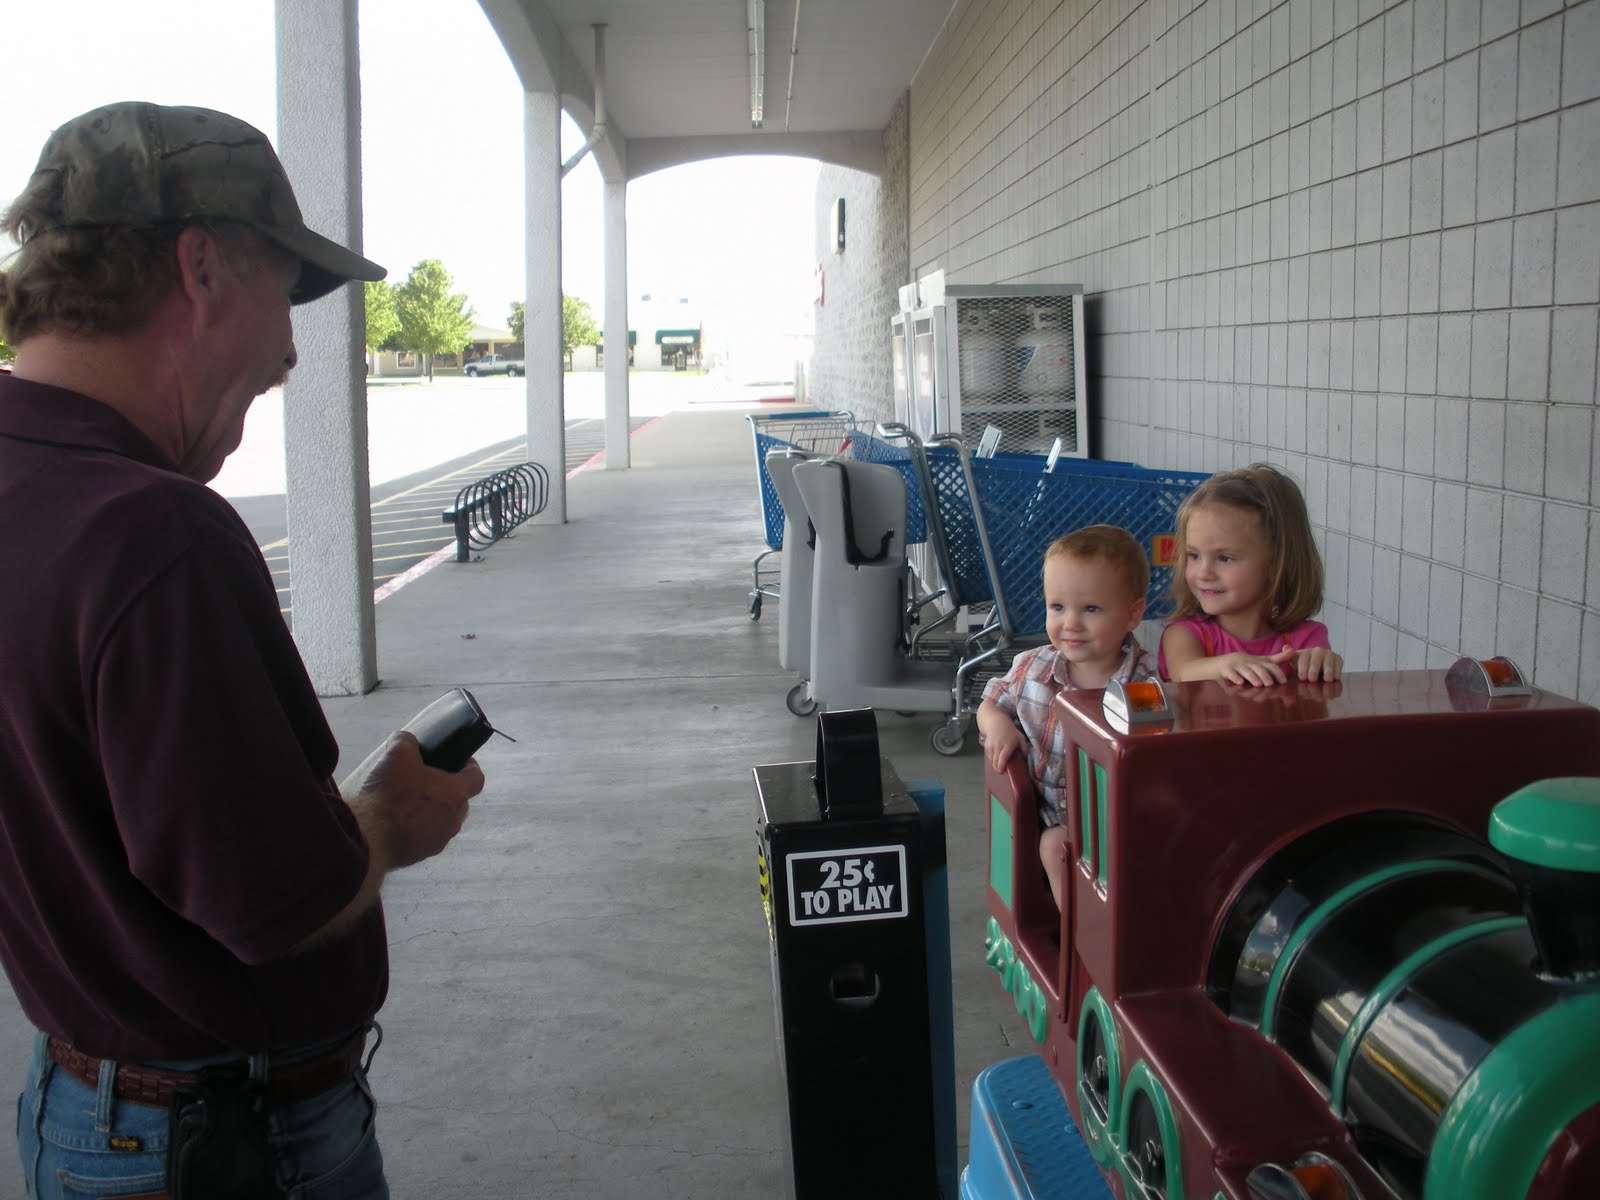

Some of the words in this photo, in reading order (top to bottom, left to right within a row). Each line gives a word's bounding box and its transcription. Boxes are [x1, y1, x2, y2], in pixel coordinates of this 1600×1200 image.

[820, 859, 875, 889] 25¢
[801, 891, 830, 915] TO
[838, 885, 894, 912] PLAY
